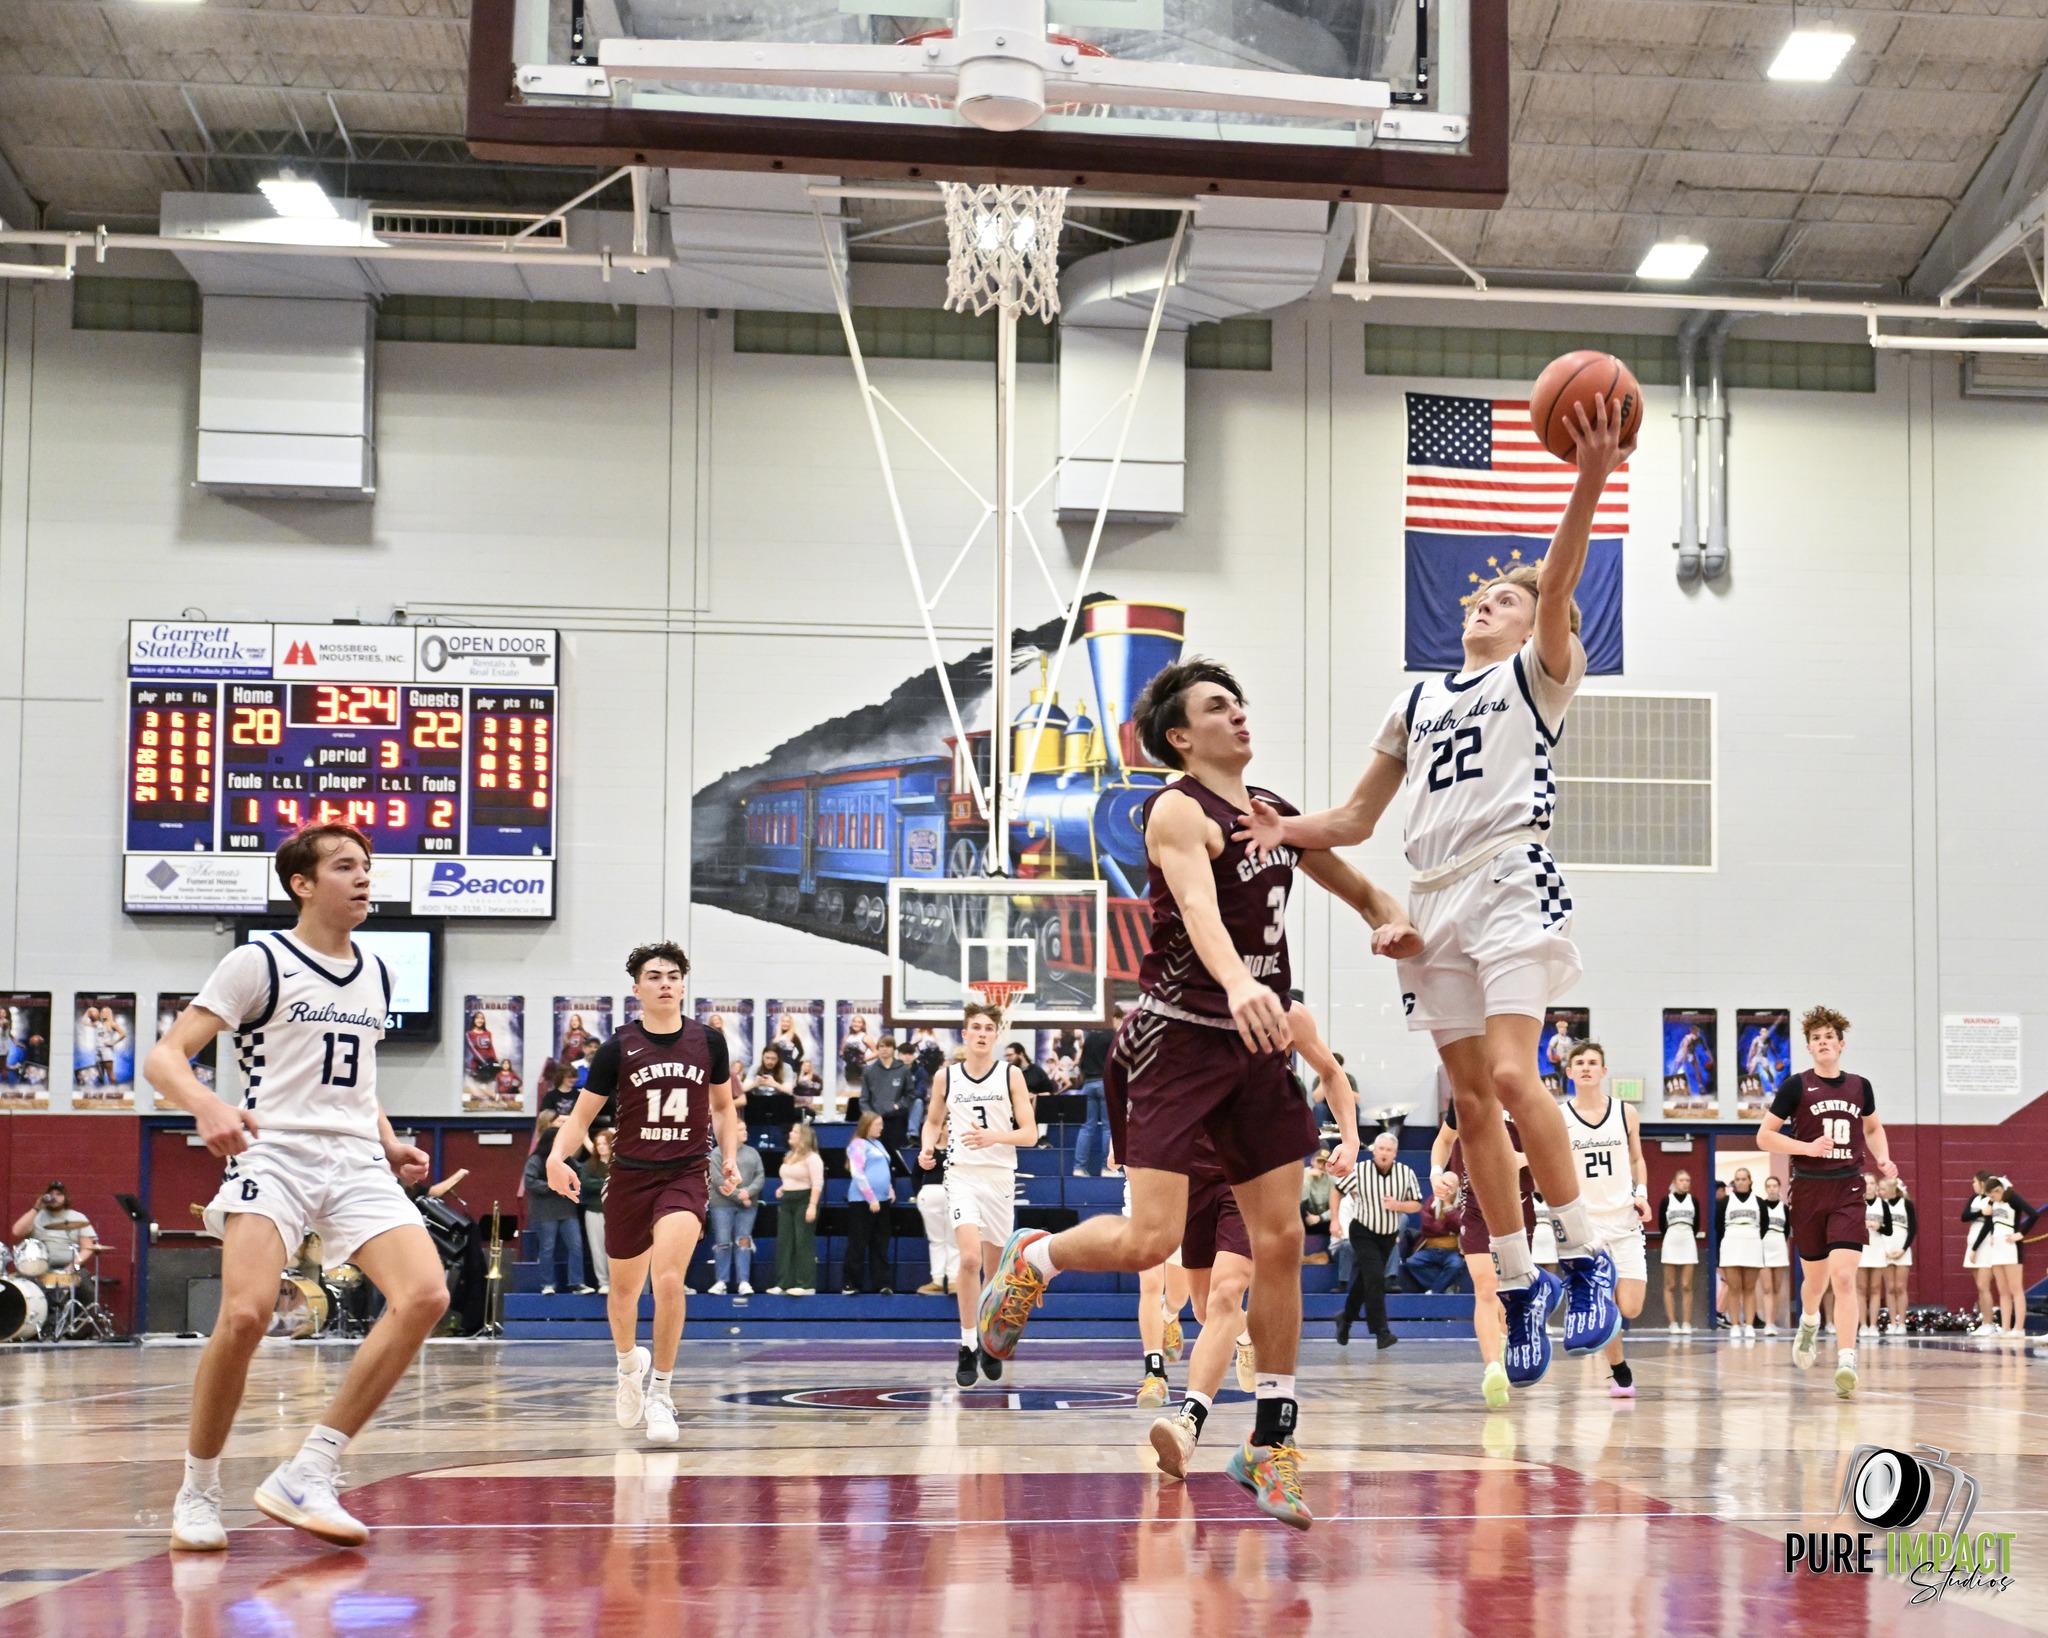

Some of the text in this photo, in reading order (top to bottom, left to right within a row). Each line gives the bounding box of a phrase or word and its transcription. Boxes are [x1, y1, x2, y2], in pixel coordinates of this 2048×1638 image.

[152, 624, 230, 642] Garrett
[135, 640, 244, 659] StateBank
[319, 644, 377, 653] MOSSBERG
[449, 637, 546, 652] OPEN DOOR
[472, 659, 506, 667] Rentals
[469, 668, 519, 677] Real Estate
[165, 691, 183, 703] pts
[233, 686, 273, 704] Home
[409, 690, 459, 707] Guests
[503, 698, 521, 710] pts
[317, 686, 396, 723] 3:24
[146, 711, 211, 728] 3 6 2
[233, 708, 281, 745] 28
[484, 717, 548, 734] 3 3 2
[1414, 695, 1509, 742] Rilrders
[171, 730, 184, 746] 0
[197, 730, 210, 747] 0
[414, 711, 462, 748] 22
[483, 737, 547, 753] 4 4 3
[170, 749, 184, 765] 6
[196, 749, 210, 765] 0
[320, 747, 366, 765] period
[381, 741, 399, 768] 3
[508, 755, 521, 771] 5
[534, 755, 547, 771] 3
[1428, 726, 1483, 793] 22
[170, 767, 183, 783] 0
[201, 768, 210, 783] 1
[228, 772, 262, 789] fouls
[320, 772, 366, 792] player
[422, 775, 456, 792] fouls
[508, 773, 521, 789] 5
[538, 774, 547, 788] 1
[195, 786, 210, 802] 2
[533, 791, 547, 808] 0
[249, 798, 258, 823] 1
[278, 799, 297, 823] 4
[387, 799, 406, 827] 3
[433, 800, 453, 827] 2
[230, 835, 258, 848] won
[424, 838, 452, 850] won
[428, 862, 545, 897] Beacon
[1263, 886, 1286, 945] 3
[321, 1032, 359, 1087] 13
[630, 1062, 705, 1087] CENTRAL
[646, 1088, 689, 1122] 14
[1810, 1099, 1861, 1119] CENTRAL
[972, 1106, 988, 1129] 3
[640, 1127, 691, 1141] NOBLE
[1822, 1118, 1850, 1145] 10
[1819, 1149, 1853, 1159] OBLE
[1584, 1151, 1612, 1178] 24
[241, 1179, 259, 1201] G
[954, 1208, 961, 1220] G
